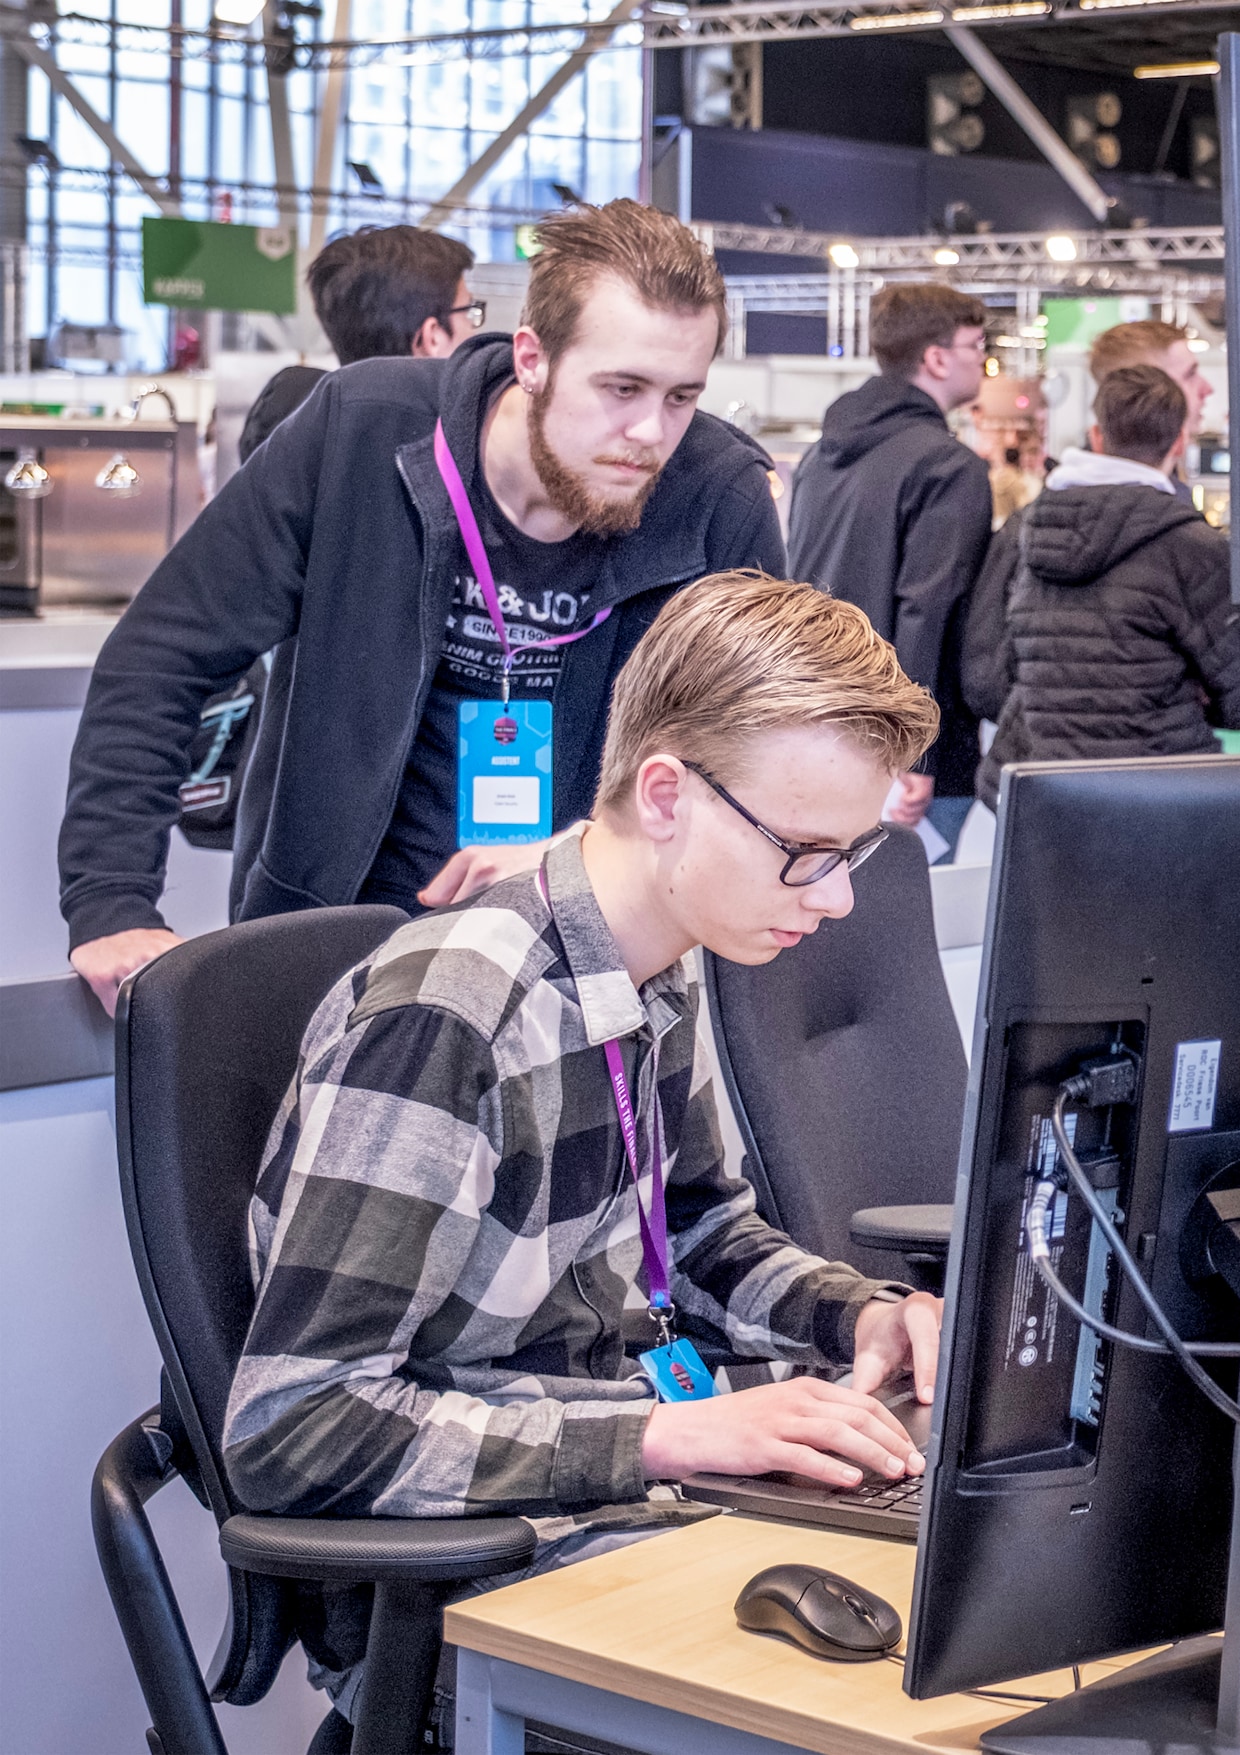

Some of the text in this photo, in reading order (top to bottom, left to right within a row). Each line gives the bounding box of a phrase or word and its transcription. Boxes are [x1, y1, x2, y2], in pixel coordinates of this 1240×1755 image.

[528, 590, 591, 626] JO
[443, 641, 484, 662] NIM
[1200, 1049, 1208, 1066] ROC
[1207, 1057, 1218, 1094] Eigendom
[615, 1072, 628, 1109] SKILLS
[622, 1108, 633, 1131] THE
